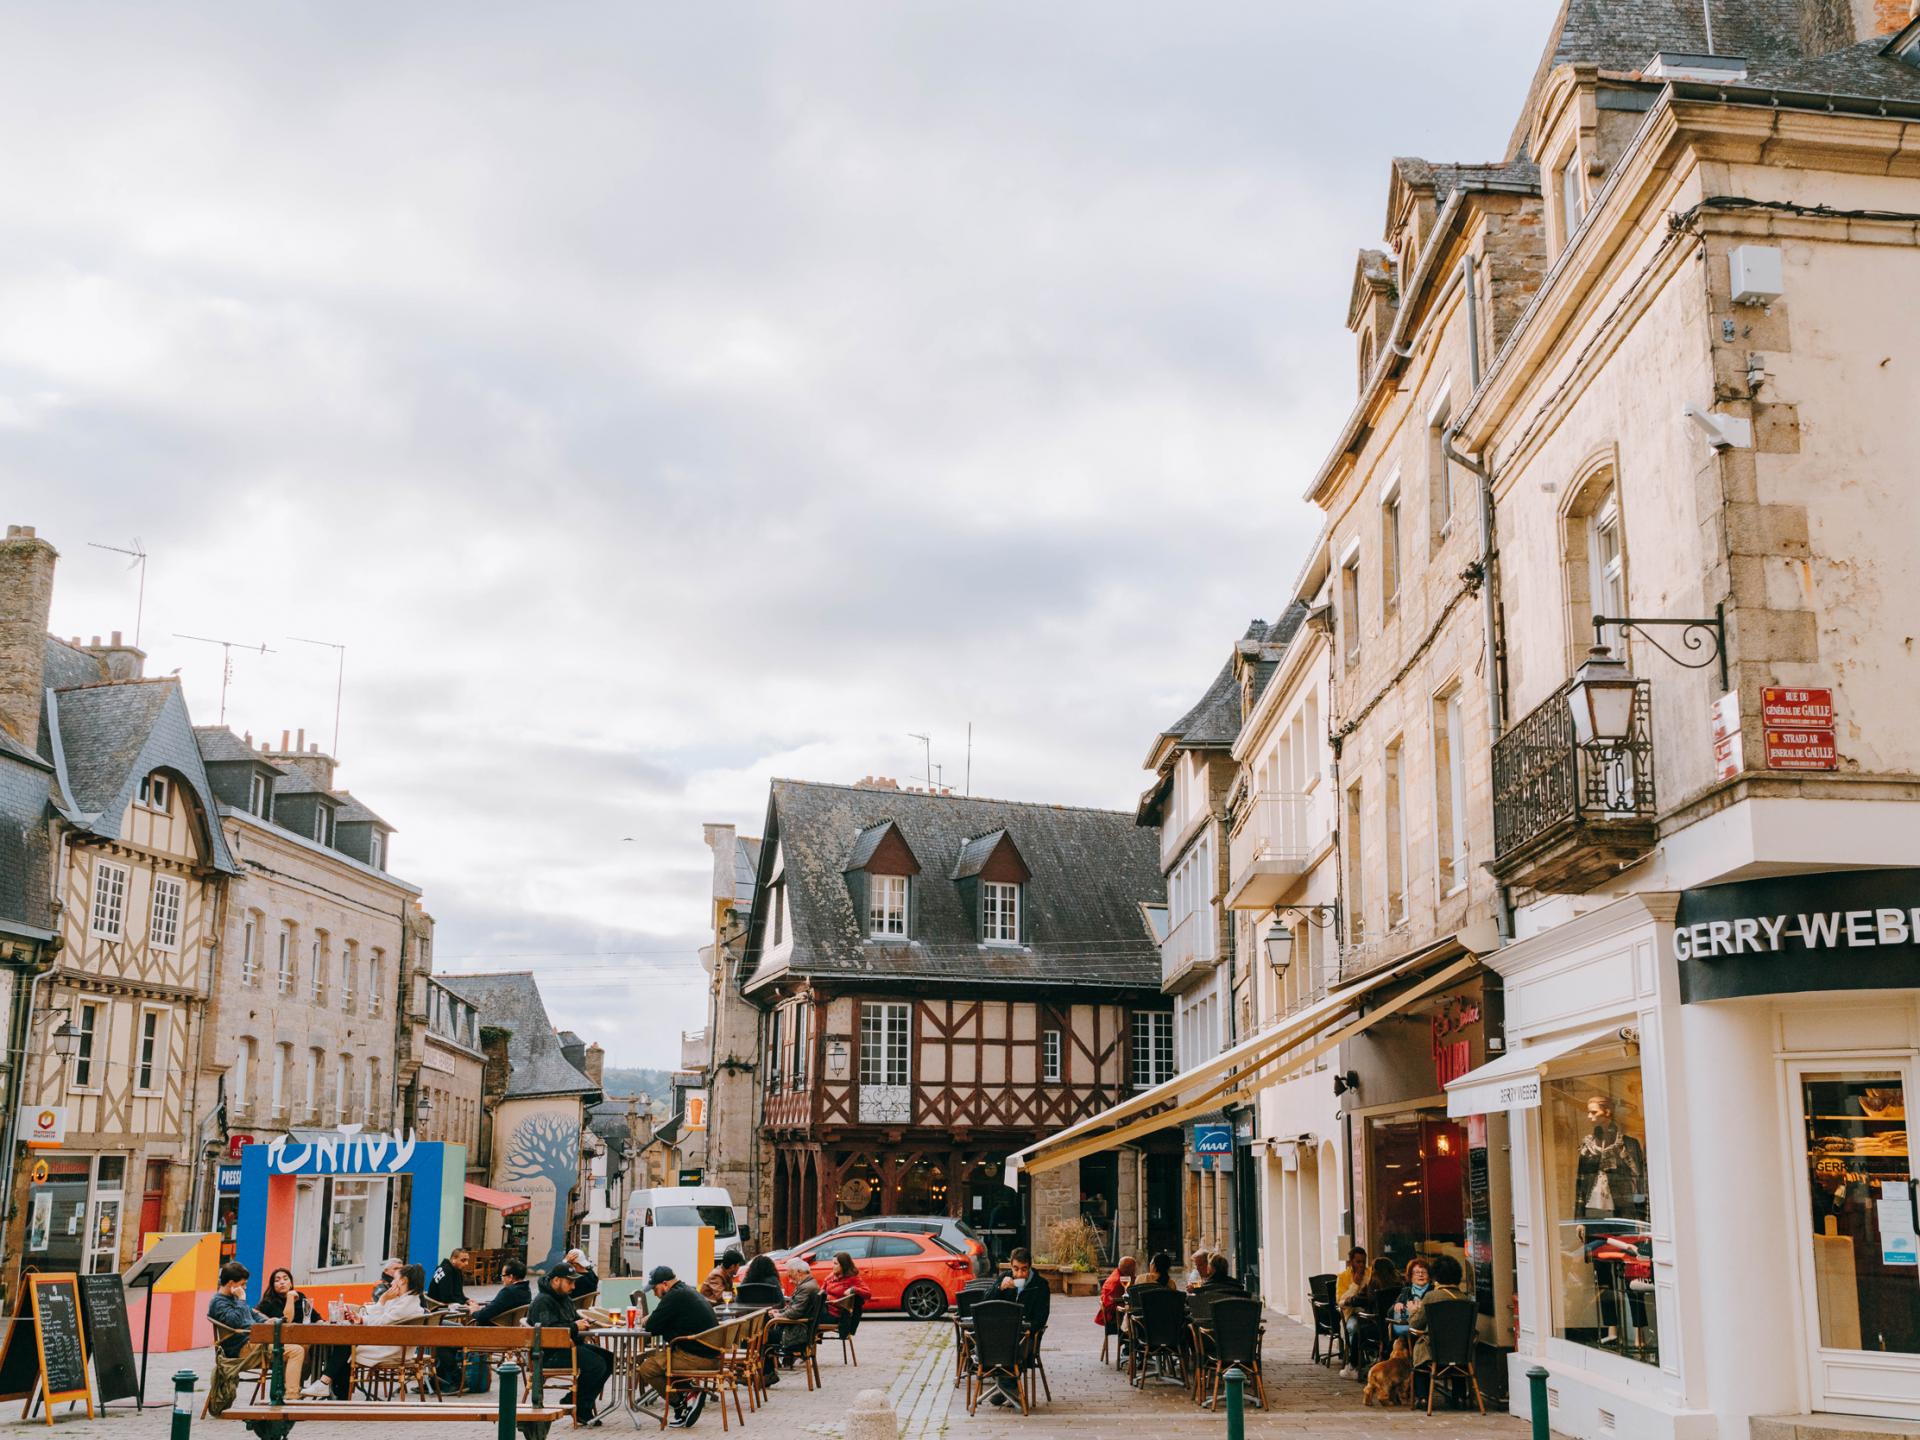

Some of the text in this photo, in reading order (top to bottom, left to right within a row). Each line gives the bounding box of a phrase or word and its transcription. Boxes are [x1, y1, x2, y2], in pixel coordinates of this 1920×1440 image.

[1785, 692, 1808, 701] RUE DU
[1793, 707, 1801, 716] DE
[1802, 705, 1831, 717] GAULLE
[1783, 734, 1818, 743] STRAED AR
[1795, 749, 1804, 758] DE
[1804, 747, 1834, 759] GAULLE
[1672, 914, 1787, 962] GERRY
[1199, 1142, 1229, 1151] MAAF
[1815, 1161, 1853, 1172] GERR
